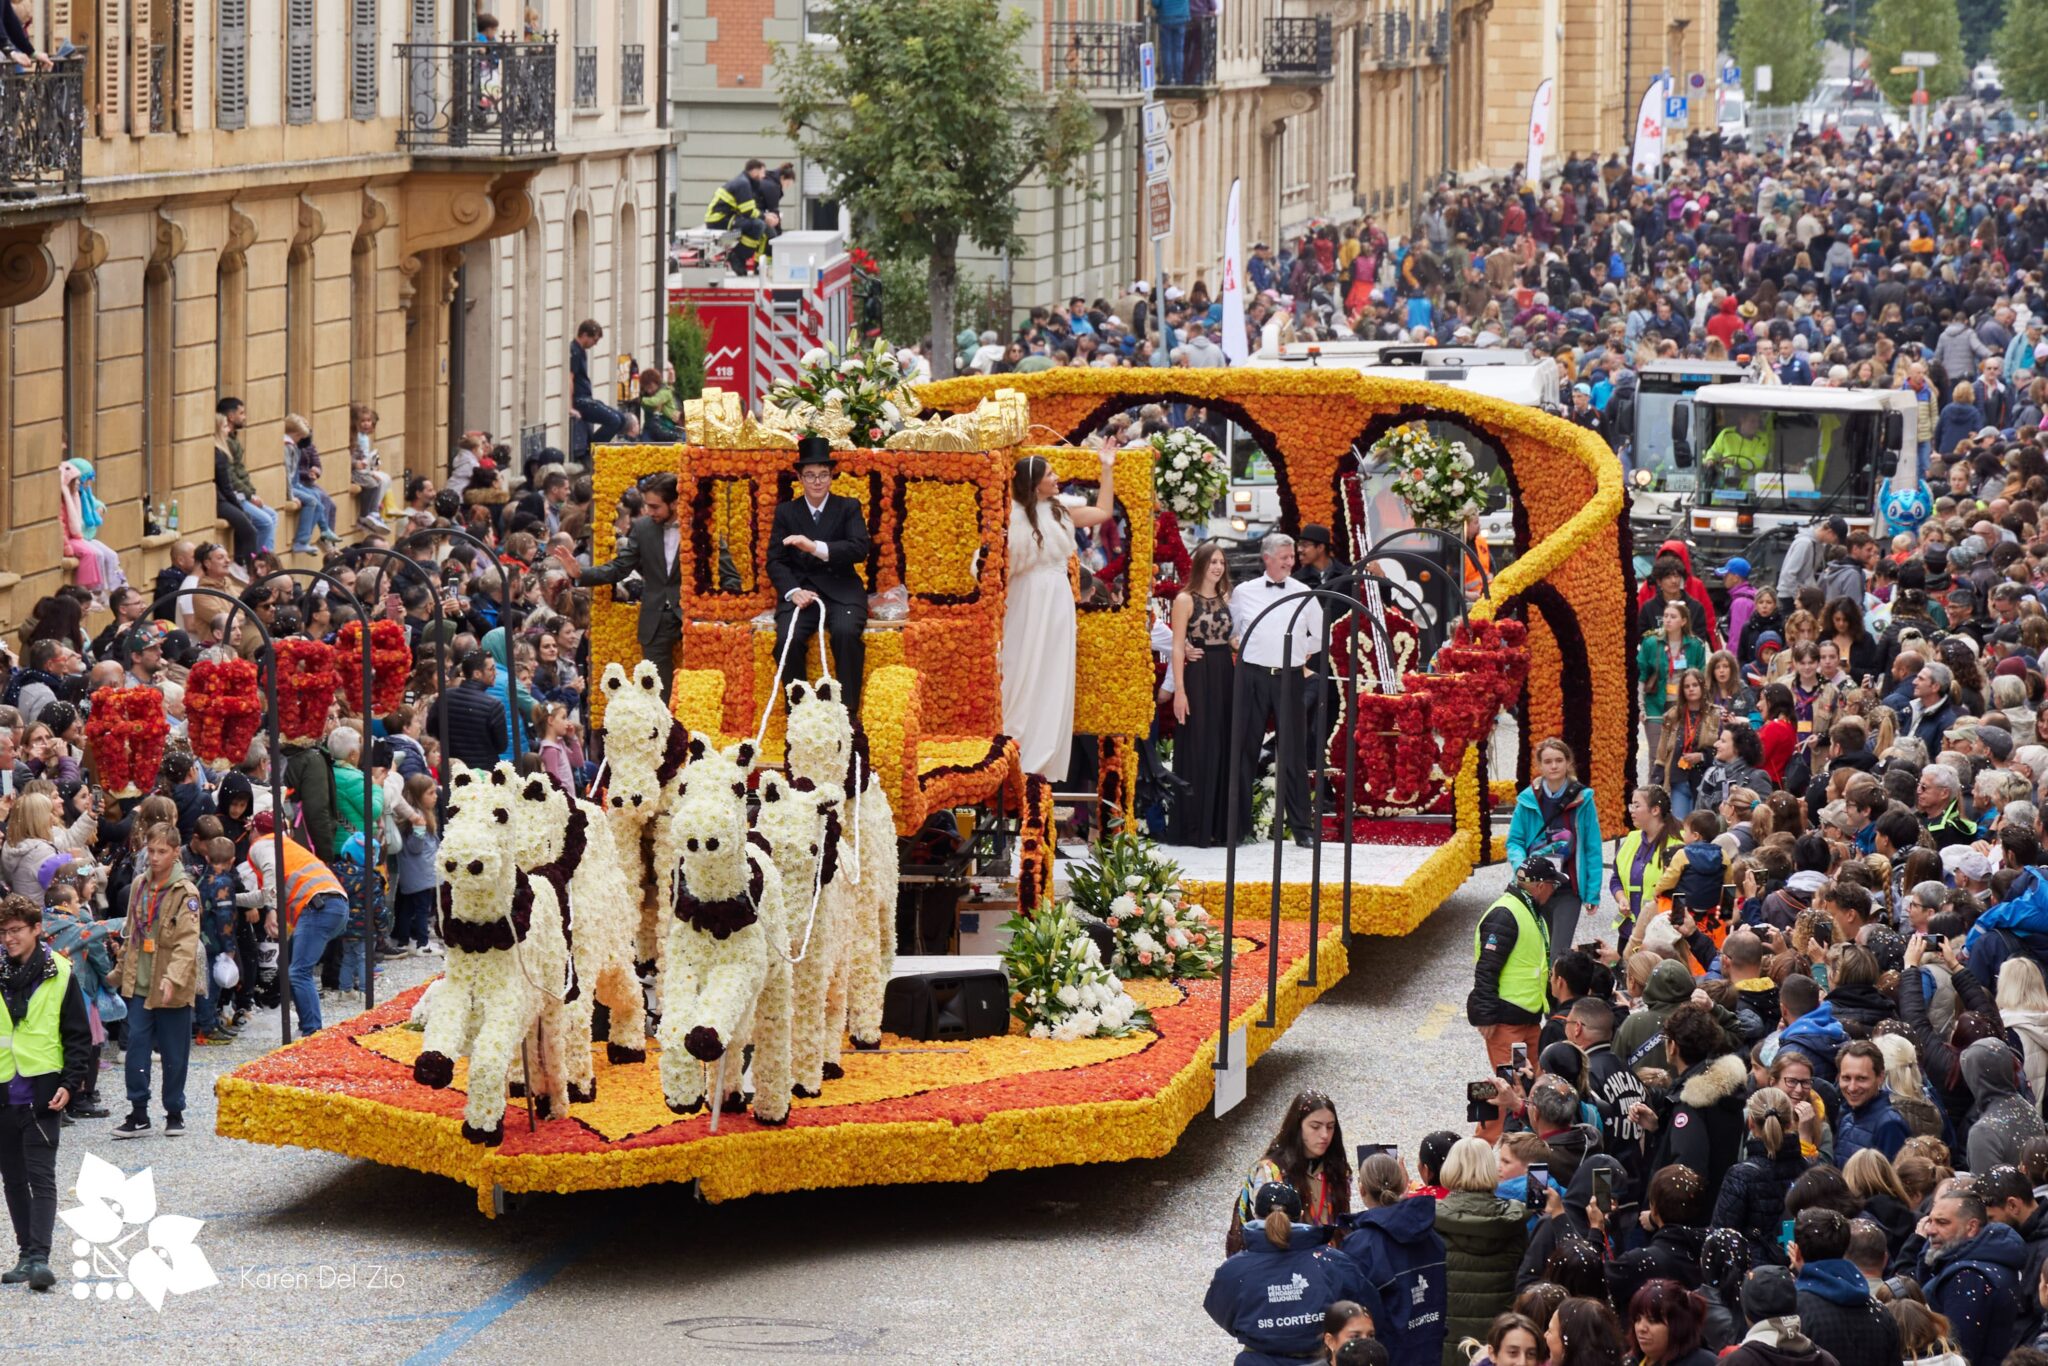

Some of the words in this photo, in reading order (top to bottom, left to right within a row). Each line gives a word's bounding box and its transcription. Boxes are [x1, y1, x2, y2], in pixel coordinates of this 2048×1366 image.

[715, 366, 734, 376] 118
[1644, 1034, 1662, 1052] adida
[1257, 1318, 1274, 1329] SIS
[1276, 1312, 1326, 1327] CORTÈGE
